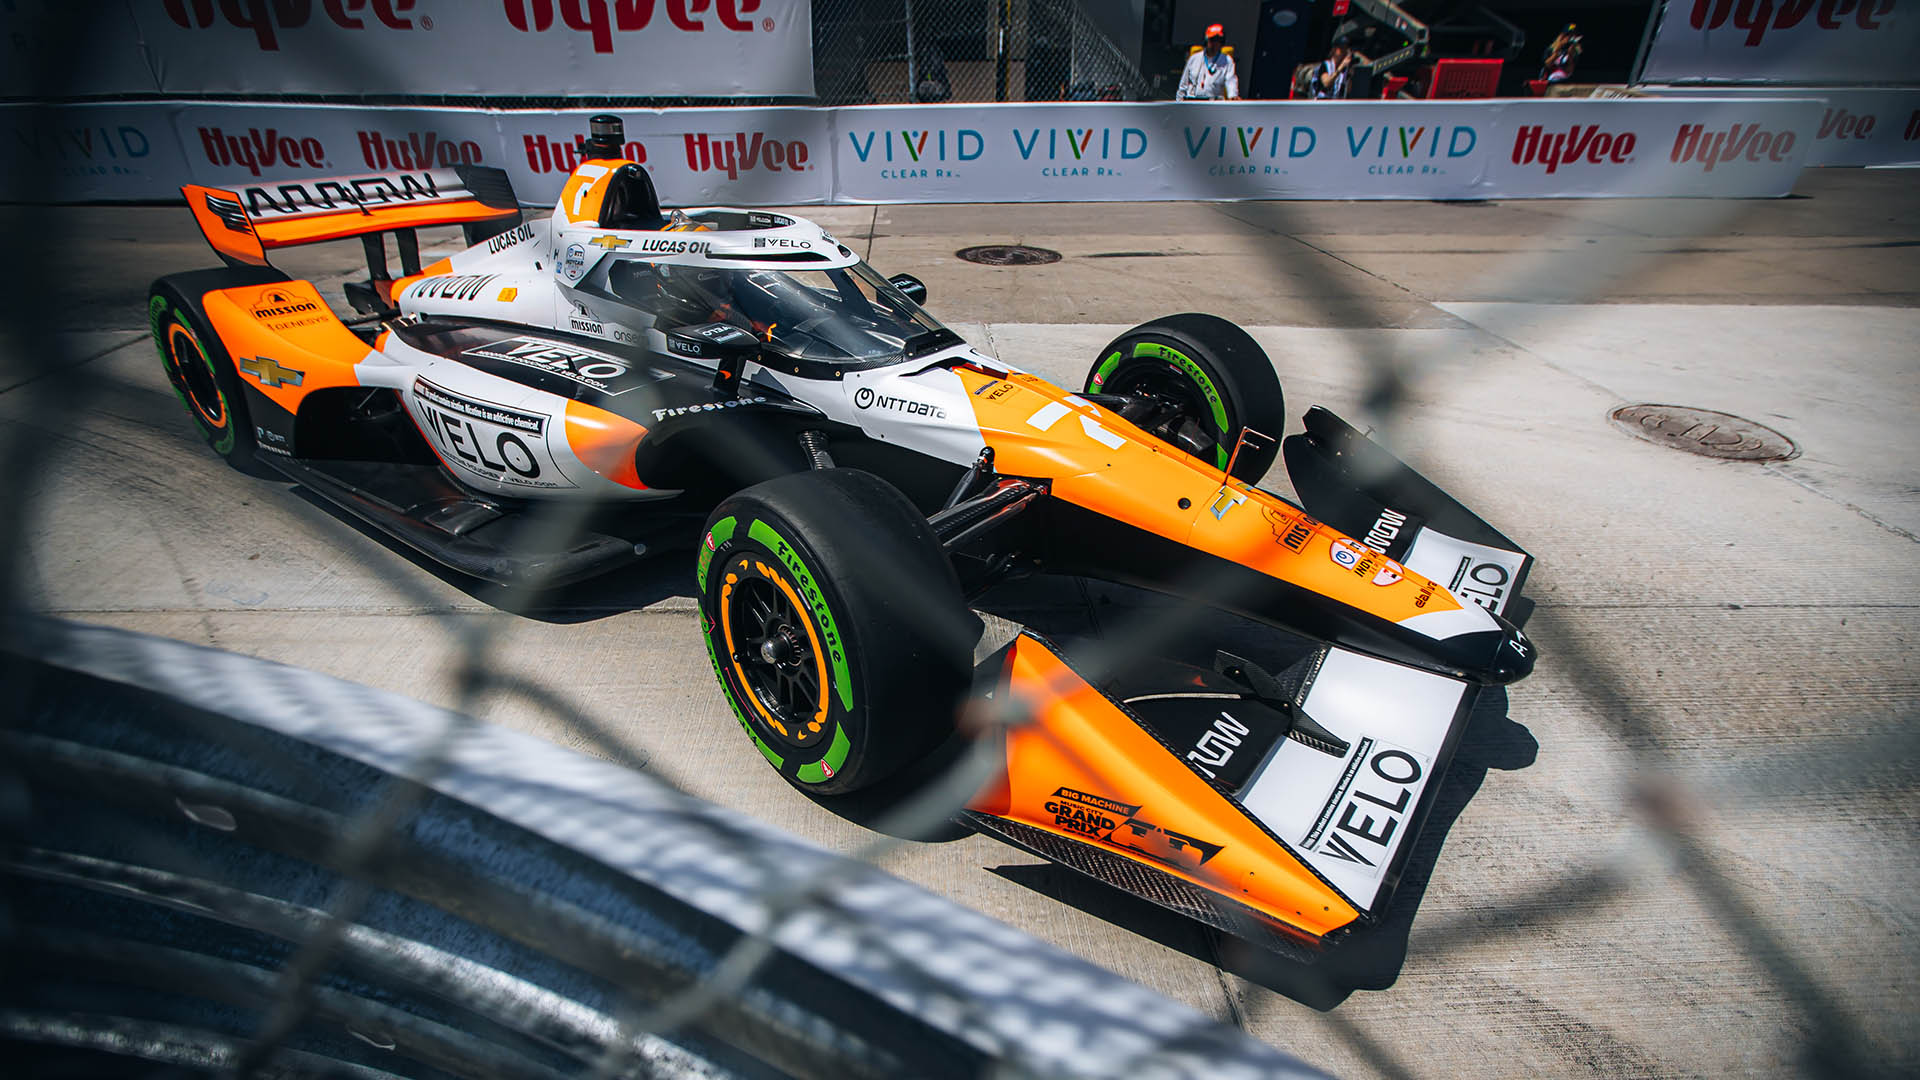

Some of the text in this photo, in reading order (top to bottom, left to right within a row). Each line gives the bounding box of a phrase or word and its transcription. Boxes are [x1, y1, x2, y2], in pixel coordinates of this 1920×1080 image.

[198, 127, 324, 176] HyVee
[523, 134, 648, 176] Hye
[684, 132, 808, 180] HyVee
[848, 130, 984, 162] VIVID
[1013, 128, 1148, 160] VIVID
[1184, 126, 1317, 159] VIVID
[1347, 126, 1477, 158] VIVID
[1511, 125, 1637, 174] HyVee
[1669, 123, 1797, 172] HyVee
[881, 170, 930, 179] CLEAR
[1042, 168, 1089, 177] CLEAR
[1208, 165, 1257, 175] CLEAR
[1368, 165, 1414, 175] CLEAR
[572, 164, 610, 216] 7
[488, 223, 535, 254] LUCAS OIL
[641, 239, 712, 254] LUCAS OIL
[768, 239, 811, 249] VELO
[255, 302, 317, 318] mission
[571, 320, 603, 335] mission
[675, 341, 700, 353] VELO
[1158, 346, 1217, 403] Firestone
[876, 395, 907, 412] NTT
[985, 383, 1013, 401] VELO
[651, 396, 767, 422] Firestone
[417, 400, 541, 478] VELO
[777, 541, 842, 664] Firestone
[1460, 562, 1509, 613] ELO
[1044, 801, 1116, 831] GRAND
[1060, 789, 1130, 814] BIG MACHINE
[1319, 749, 1422, 868] VELO
[1055, 815, 1101, 838] PRIX
